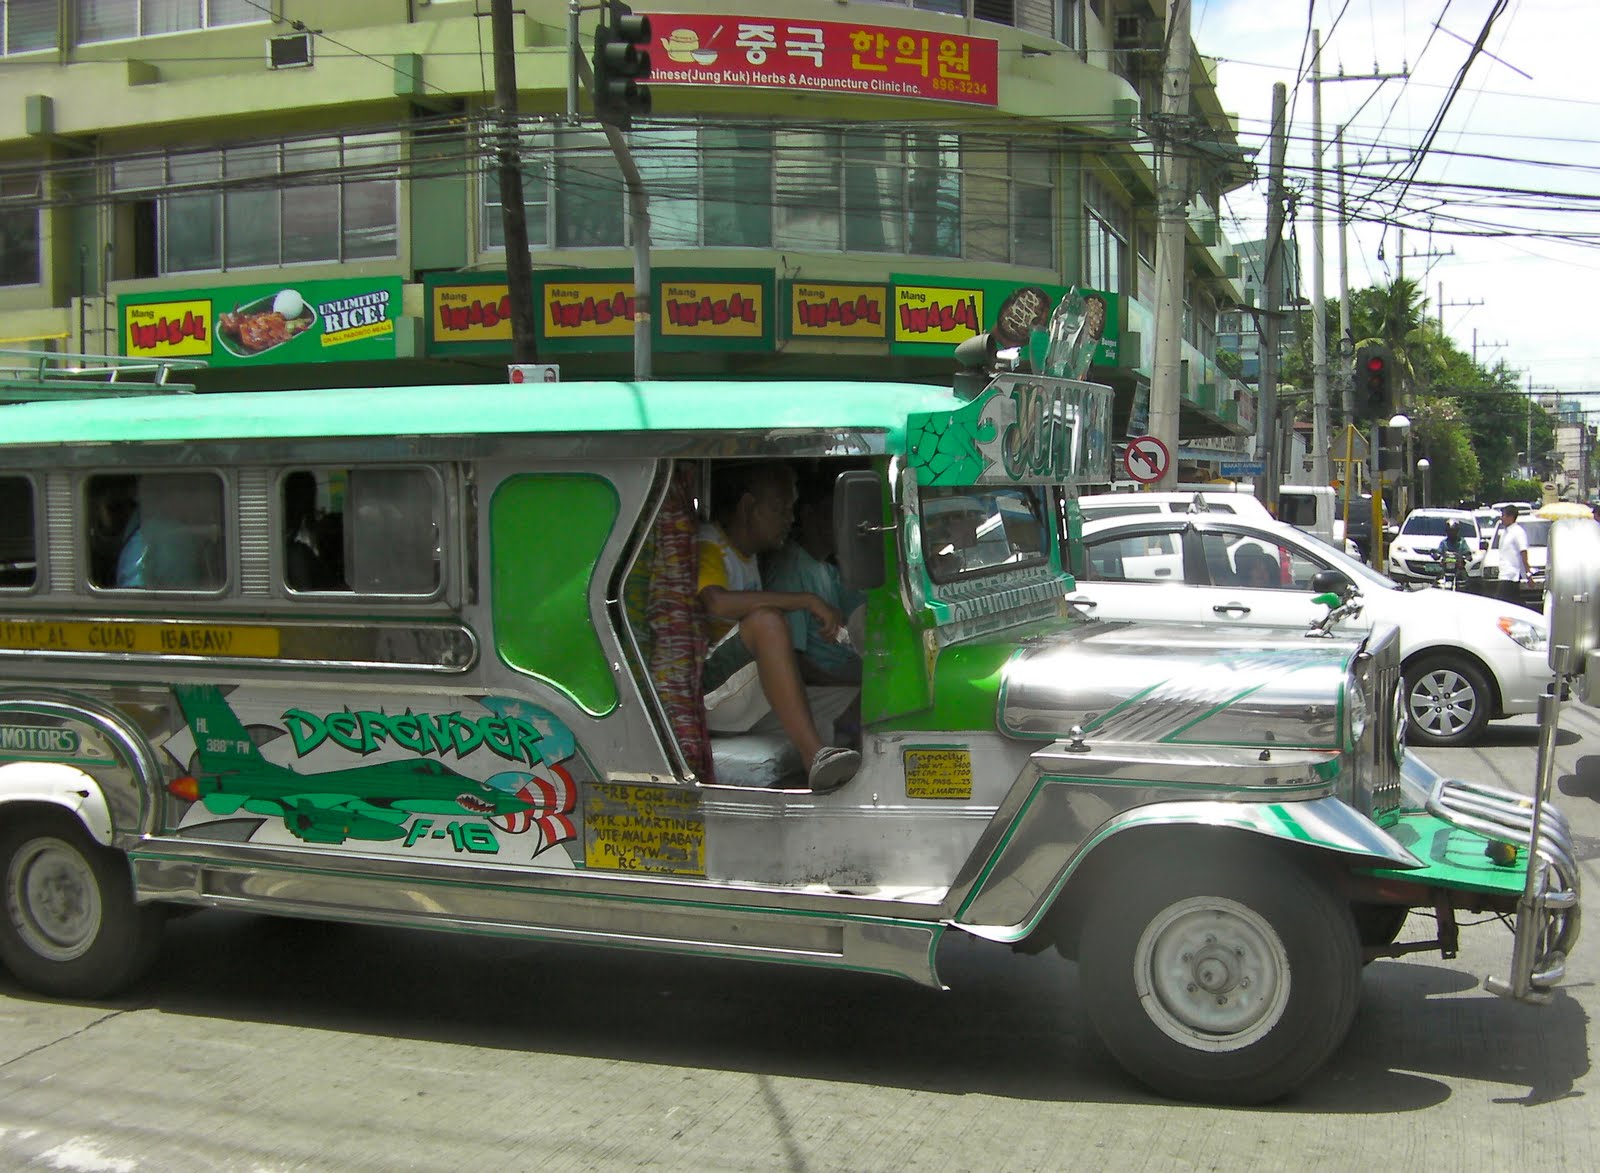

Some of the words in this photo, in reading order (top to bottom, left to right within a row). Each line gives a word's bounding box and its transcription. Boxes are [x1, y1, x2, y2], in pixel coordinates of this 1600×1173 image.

[736, 24, 826, 68] 중국
[849, 30, 971, 81] 한의원
[723, 70, 750, 84] Kuk)
[752, 71, 786, 84] Herbs
[788, 74, 797, 85] &
[799, 74, 868, 91] Acupuncture
[870, 79, 900, 92] Clinic
[902, 81, 921, 94] Inc.
[932, 78, 987, 95] 896-3234
[318, 290, 390, 316] UNLIMITED
[441, 292, 467, 302] Mang
[552, 289, 579, 299] Mang
[667, 287, 696, 298] Mang
[798, 287, 826, 298] Mang
[901, 291, 926, 302] Mang
[131, 309, 155, 319] Mang
[323, 303, 387, 334] RICE!
[440, 294, 512, 331] INASA
[666, 292, 757, 328] INASAL
[797, 294, 882, 328] INASAL
[130, 309, 207, 349] INASAL
[1, 727, 75, 751] MOTORS
[280, 705, 544, 768] DEFENDER
[402, 818, 501, 855] F-16
